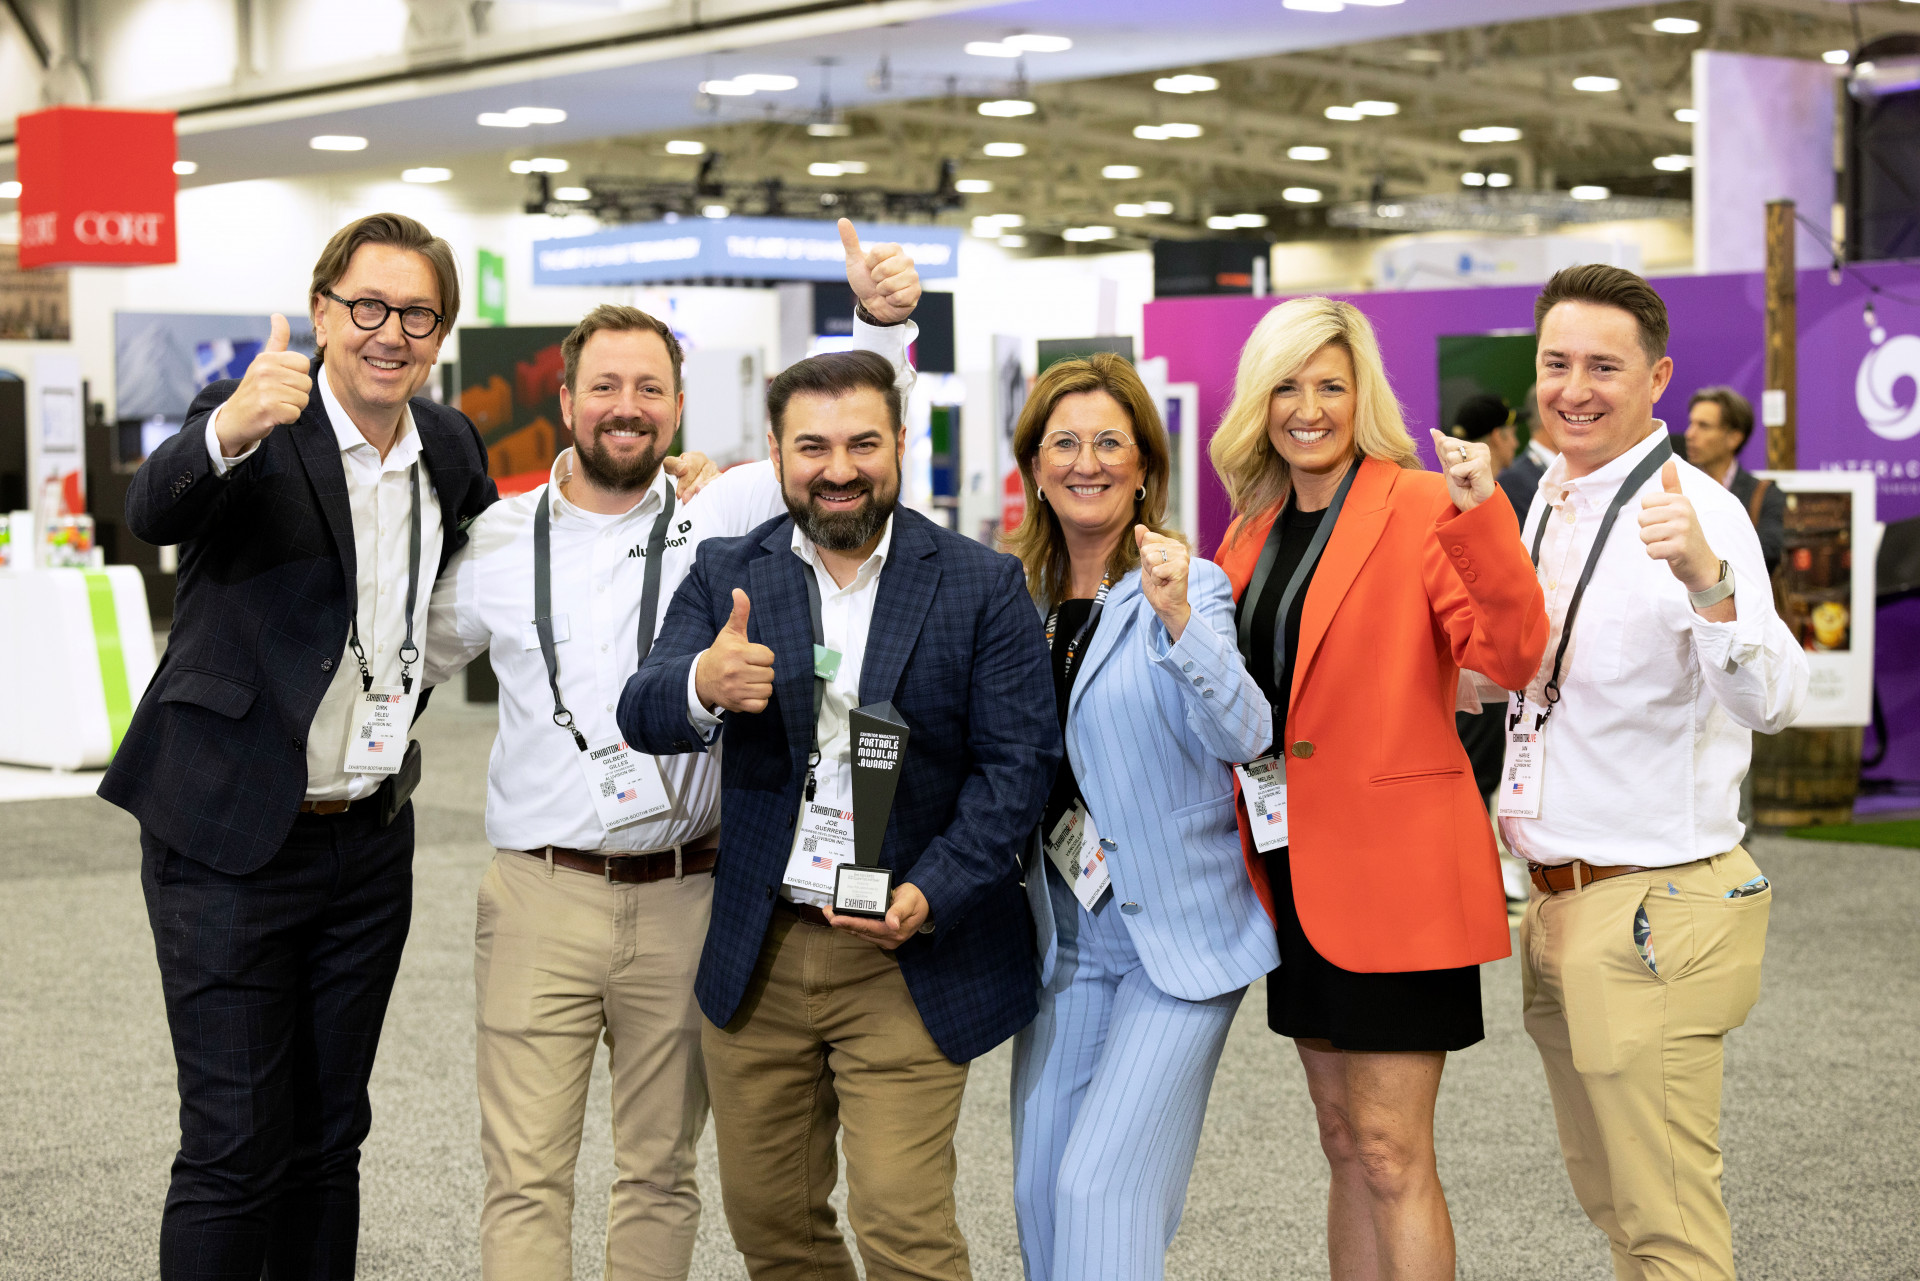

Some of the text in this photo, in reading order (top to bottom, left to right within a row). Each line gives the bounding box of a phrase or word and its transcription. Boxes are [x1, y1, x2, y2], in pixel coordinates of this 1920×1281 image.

[73, 210, 165, 246] CORT
[628, 536, 687, 558] Alusion
[859, 737, 899, 750] PORTABLE
[590, 741, 629, 761] EXHIBITORLIV
[858, 747, 898, 760] MODULAR
[602, 752, 629, 765] GILBERT
[859, 758, 894, 770] AWARDS
[815, 825, 848, 836] GUERRERO
[844, 898, 877, 910] EXHIBITOR
